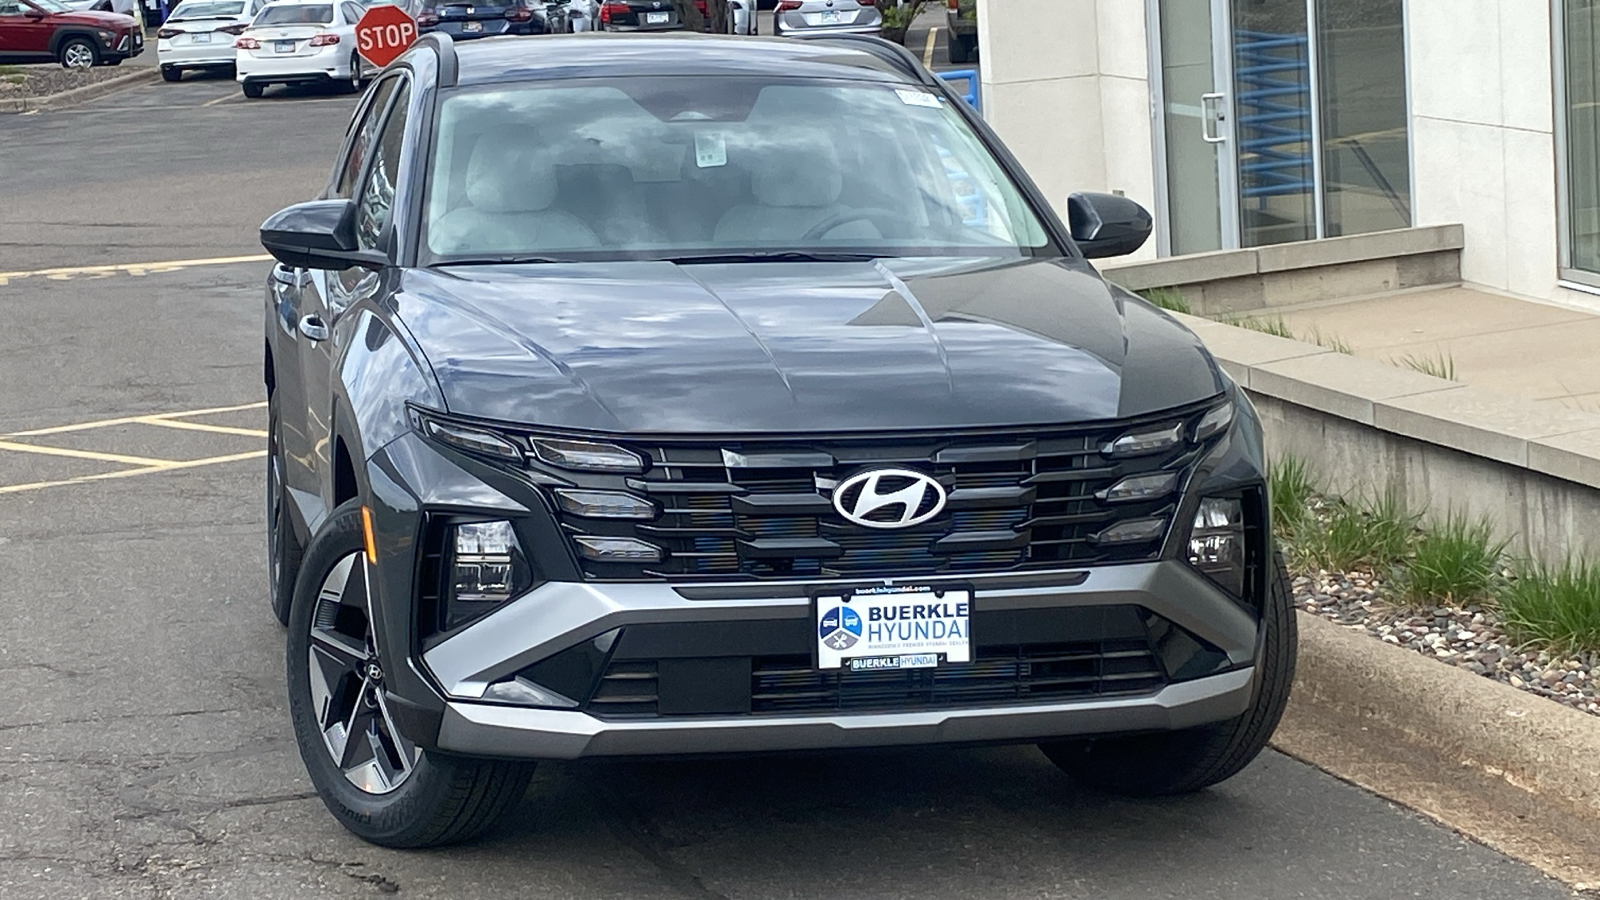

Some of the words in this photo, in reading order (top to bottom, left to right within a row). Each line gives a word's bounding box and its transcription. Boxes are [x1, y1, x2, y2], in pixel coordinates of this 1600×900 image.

[360, 23, 413, 50] STOP
[868, 603, 968, 621] BUERKLE
[868, 619, 968, 642] HYUNDAI
[852, 657, 899, 669] BUERKLE
[901, 656, 936, 666] HYUNDAI
